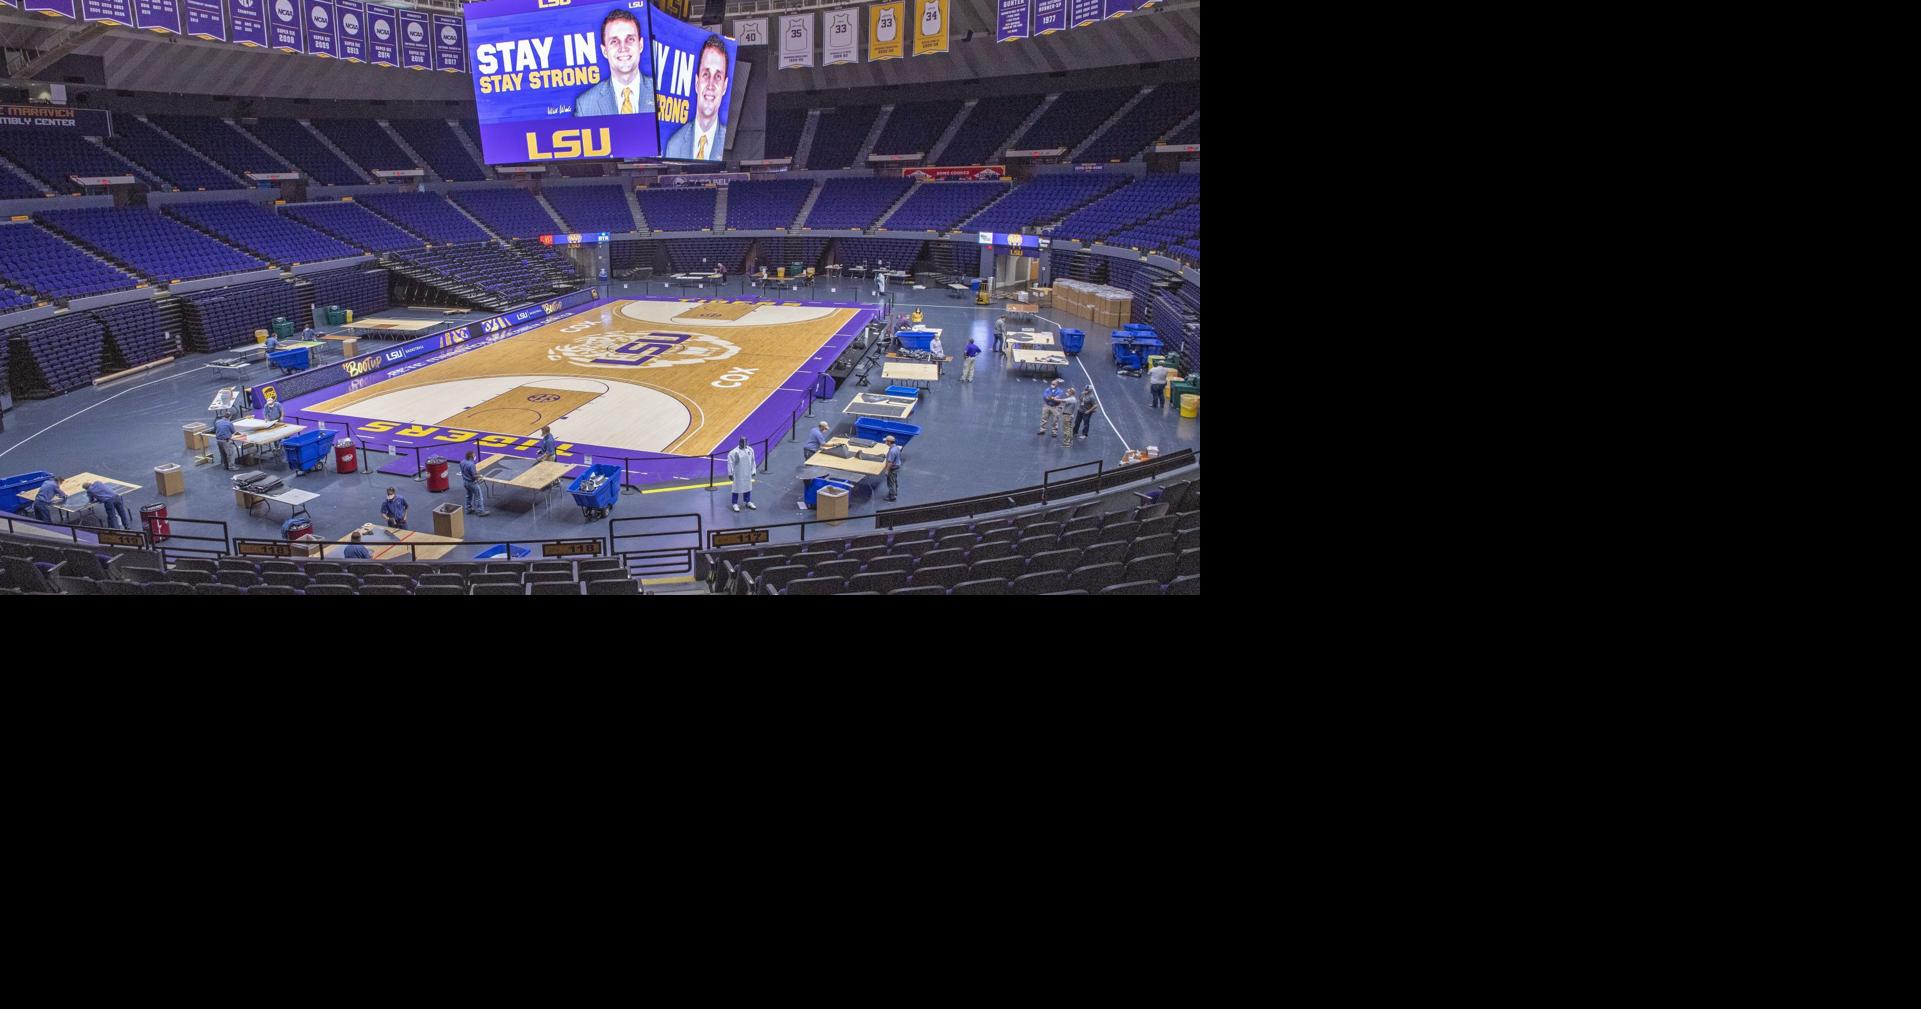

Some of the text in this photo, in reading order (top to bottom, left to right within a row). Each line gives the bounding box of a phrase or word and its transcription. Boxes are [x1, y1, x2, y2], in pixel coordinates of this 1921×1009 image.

[628, 1, 644, 9] LSU
[926, 11, 937, 21] 34
[1043, 15, 1056, 25] 1977
[881, 18, 893, 28] 33
[791, 29, 802, 38] 35
[835, 24, 847, 33] 33
[745, 33, 756, 42] 40
[476, 32, 597, 75] STAY IN
[670, 48, 695, 97] IN
[480, 65, 600, 94] STAY STRONG
[8, 107, 75, 118] MARAVICH
[35, 118, 76, 127] CENTER
[526, 127, 612, 160] LSU
[560, 320, 602, 333] COX
[386, 350, 403, 361] LSU
[711, 366, 759, 388] COX
